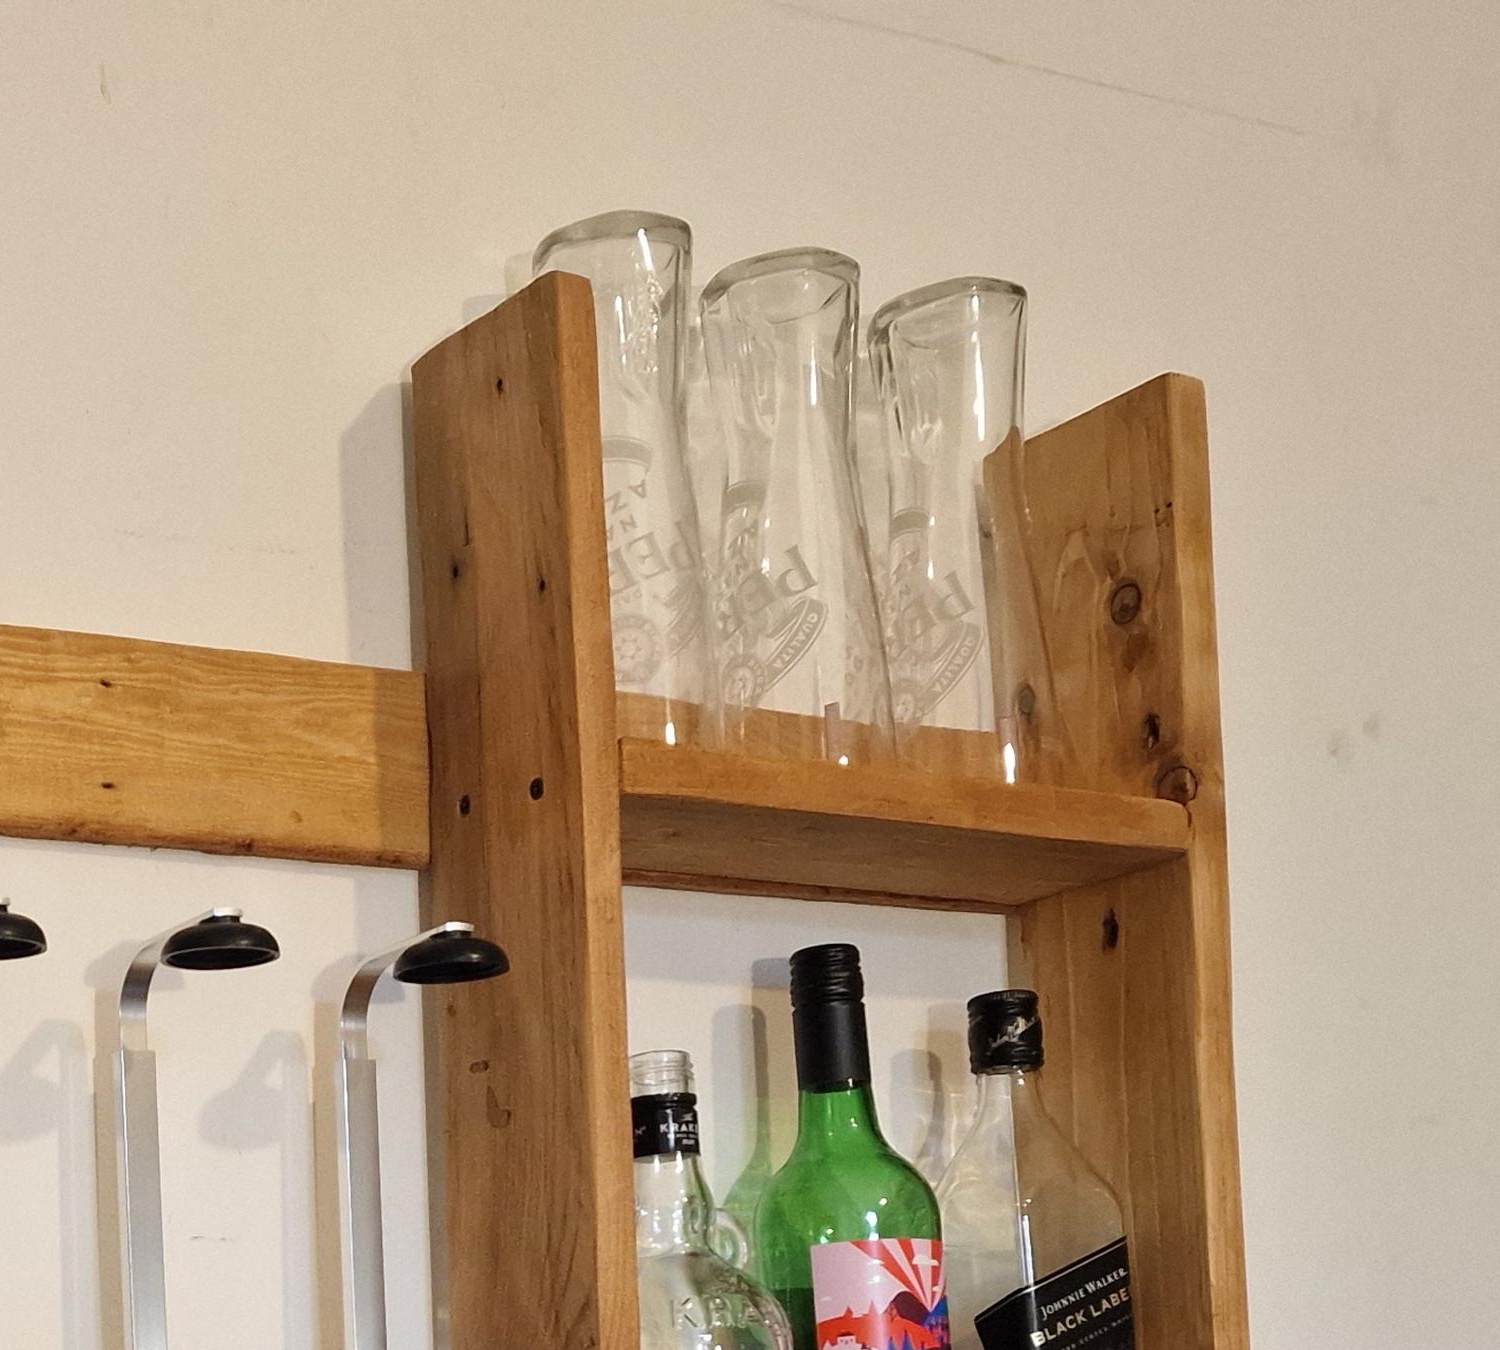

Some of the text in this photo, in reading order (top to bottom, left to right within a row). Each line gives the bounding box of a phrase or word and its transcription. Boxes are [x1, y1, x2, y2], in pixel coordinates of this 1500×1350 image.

[1030, 1287, 1130, 1348] BLACK LABE
[1040, 1267, 1128, 1321] JOHNNIE WALKER
